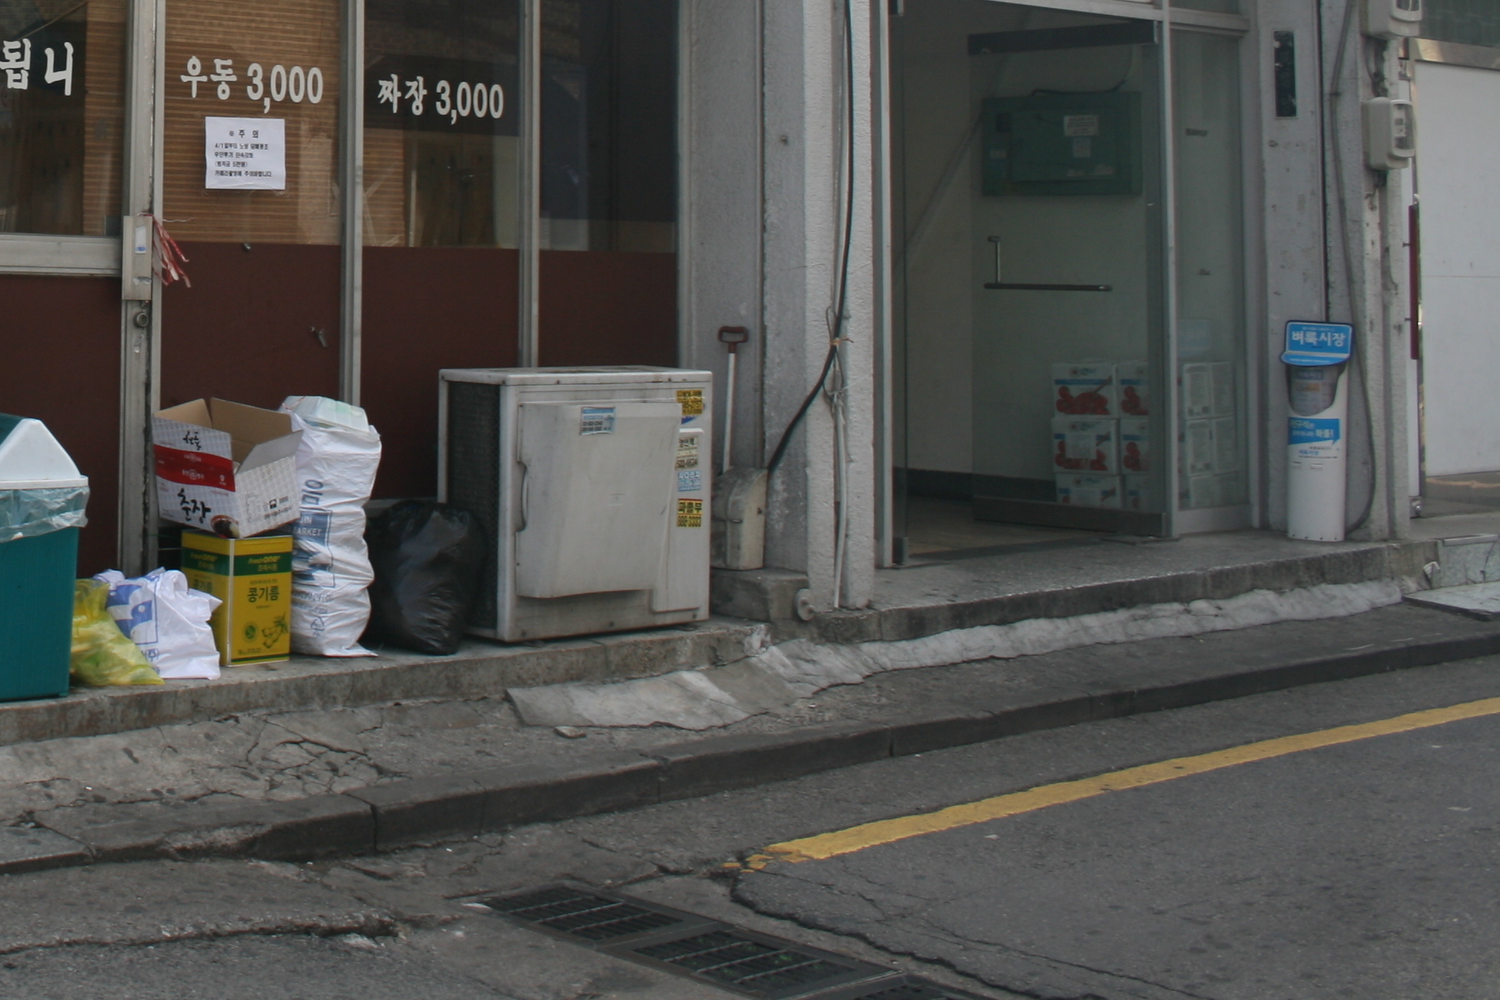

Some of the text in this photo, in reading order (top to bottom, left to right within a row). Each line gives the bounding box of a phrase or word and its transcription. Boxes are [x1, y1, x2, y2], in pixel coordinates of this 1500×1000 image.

[180, 55, 324, 114] 우동 3,000
[377, 73, 504, 125] 짜장 3,000
[1292, 331, 1346, 347] 벼룩시장
[247, 586, 279, 603] 콩기름
